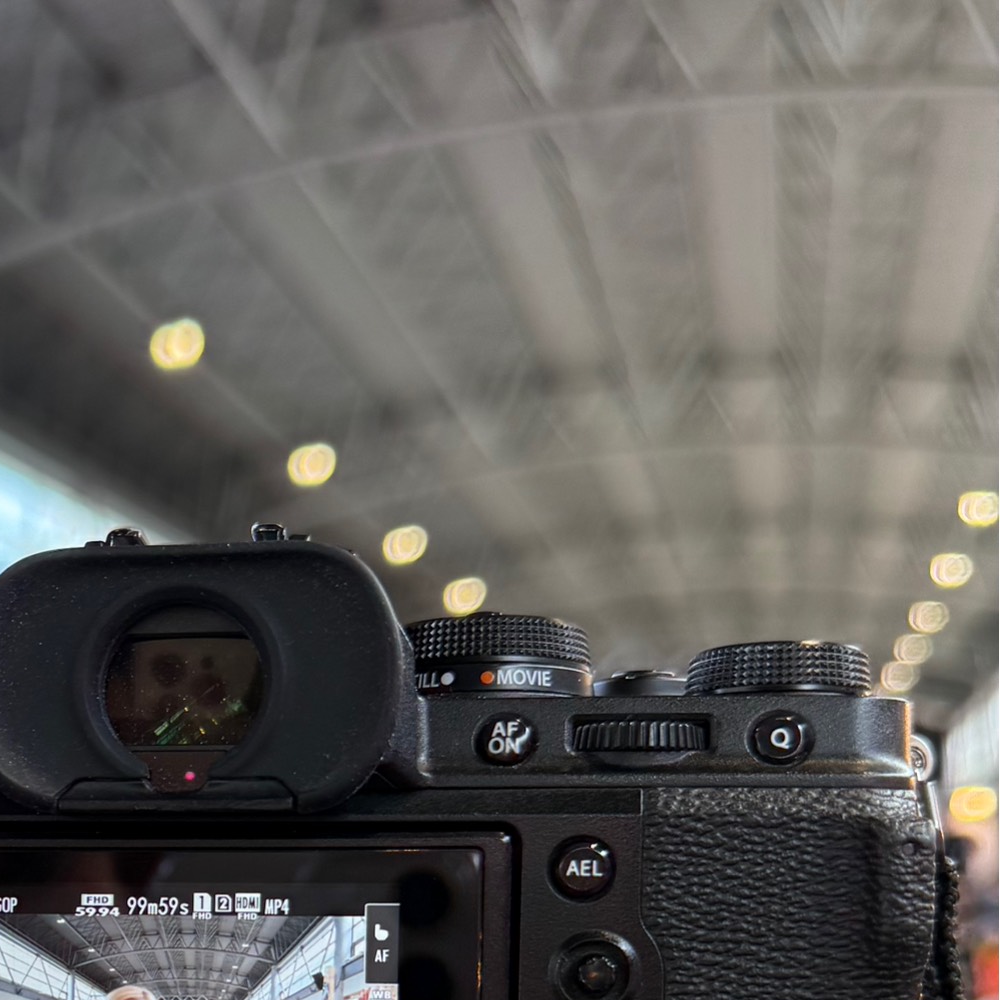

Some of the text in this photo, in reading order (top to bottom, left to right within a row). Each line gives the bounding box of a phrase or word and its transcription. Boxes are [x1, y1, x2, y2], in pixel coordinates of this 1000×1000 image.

[416, 672, 440, 689] ILL
[496, 669, 552, 687] MOVIE
[491, 721, 519, 738] AF
[488, 737, 520, 755] ON
[770, 728, 790, 749] Q
[565, 859, 603, 878] AEL
[86, 896, 109, 904] FHD
[126, 896, 189, 916] 99m59s
[219, 897, 228, 910] 2
[236, 896, 260, 909] HDMI
[264, 898, 290, 915] MP4
[74, 906, 120, 917] 59.94
[192, 912, 212, 920] FHD
[237, 912, 258, 921] FHD
[374, 949, 390, 963] AF
